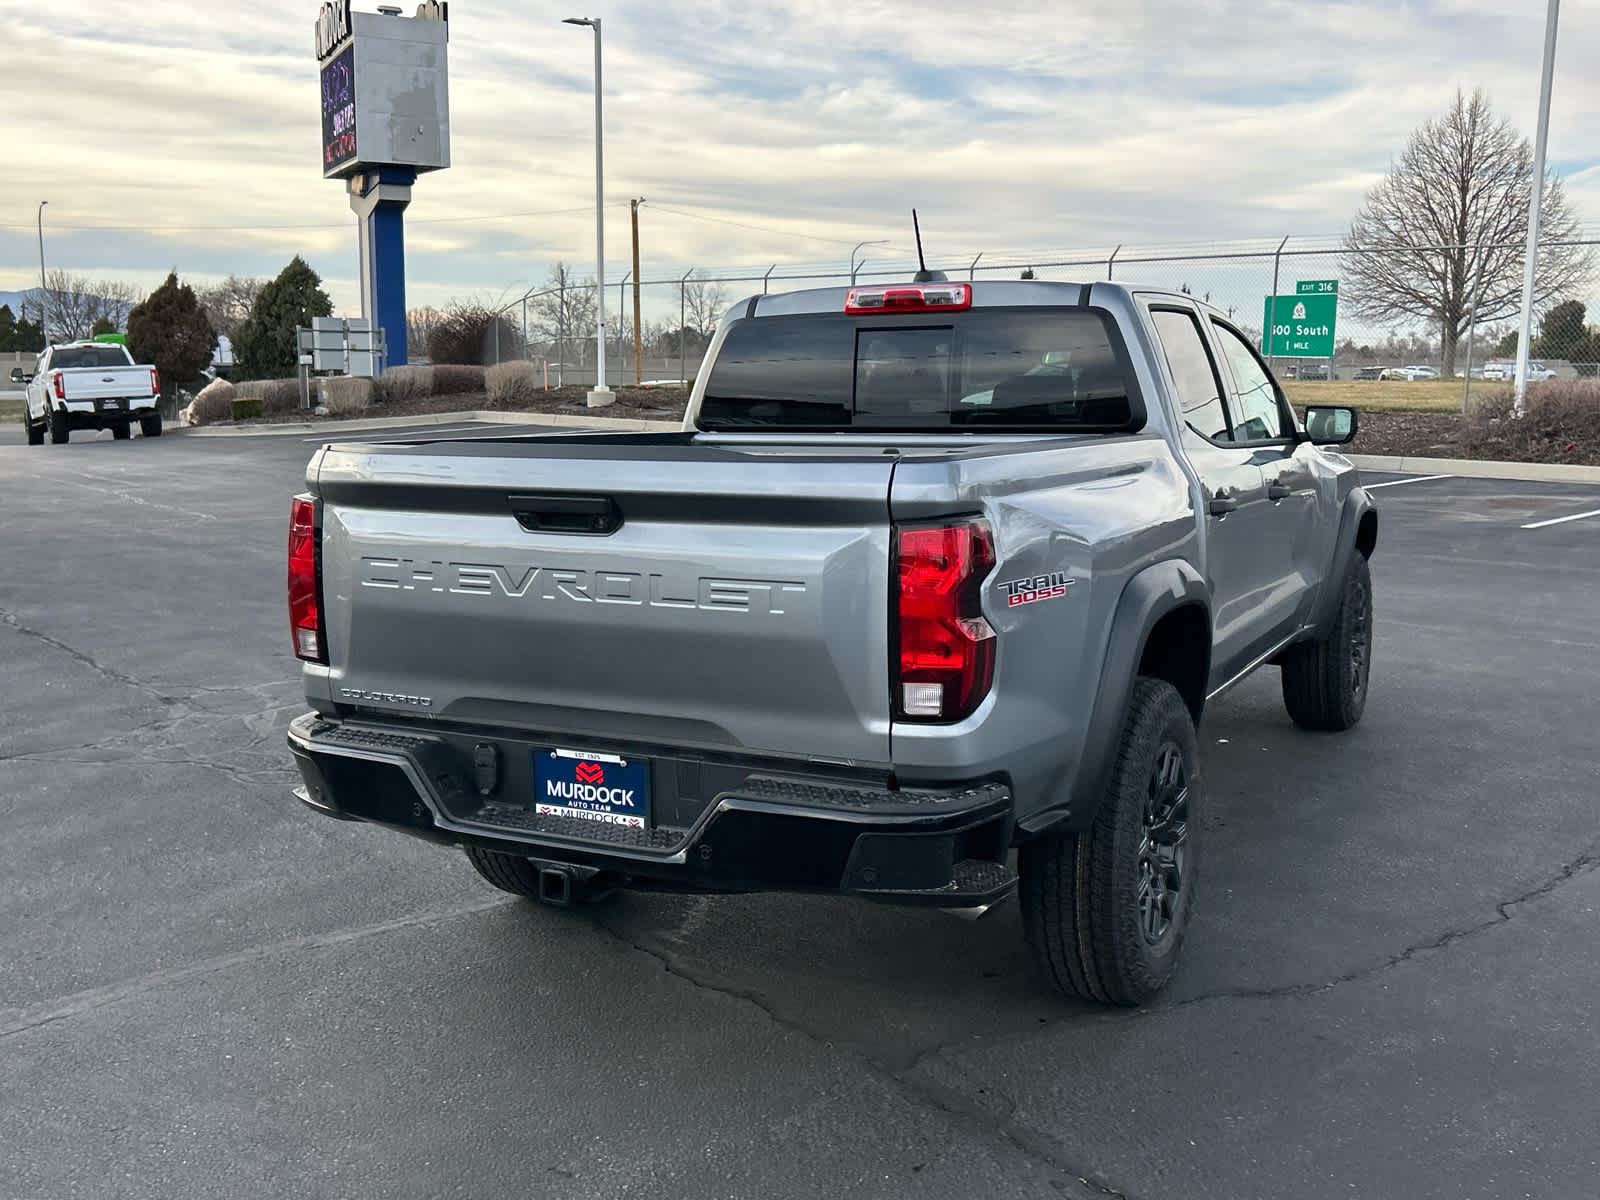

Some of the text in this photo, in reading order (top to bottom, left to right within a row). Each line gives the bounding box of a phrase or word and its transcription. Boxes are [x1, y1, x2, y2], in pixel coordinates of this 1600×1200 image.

[1318, 283, 1333, 291] 316
[1296, 325, 1328, 335] South
[1286, 340, 1309, 351] 1 MILE
[361, 556, 807, 615] CHEVROLET
[998, 571, 1076, 595] TRAIL
[1008, 585, 1066, 608] BOSS
[340, 688, 433, 706] COLORADO
[546, 779, 635, 807] MURDOCK
[567, 801, 611, 812] AUTO TEAM
[560, 808, 620, 825] MURDOCK
